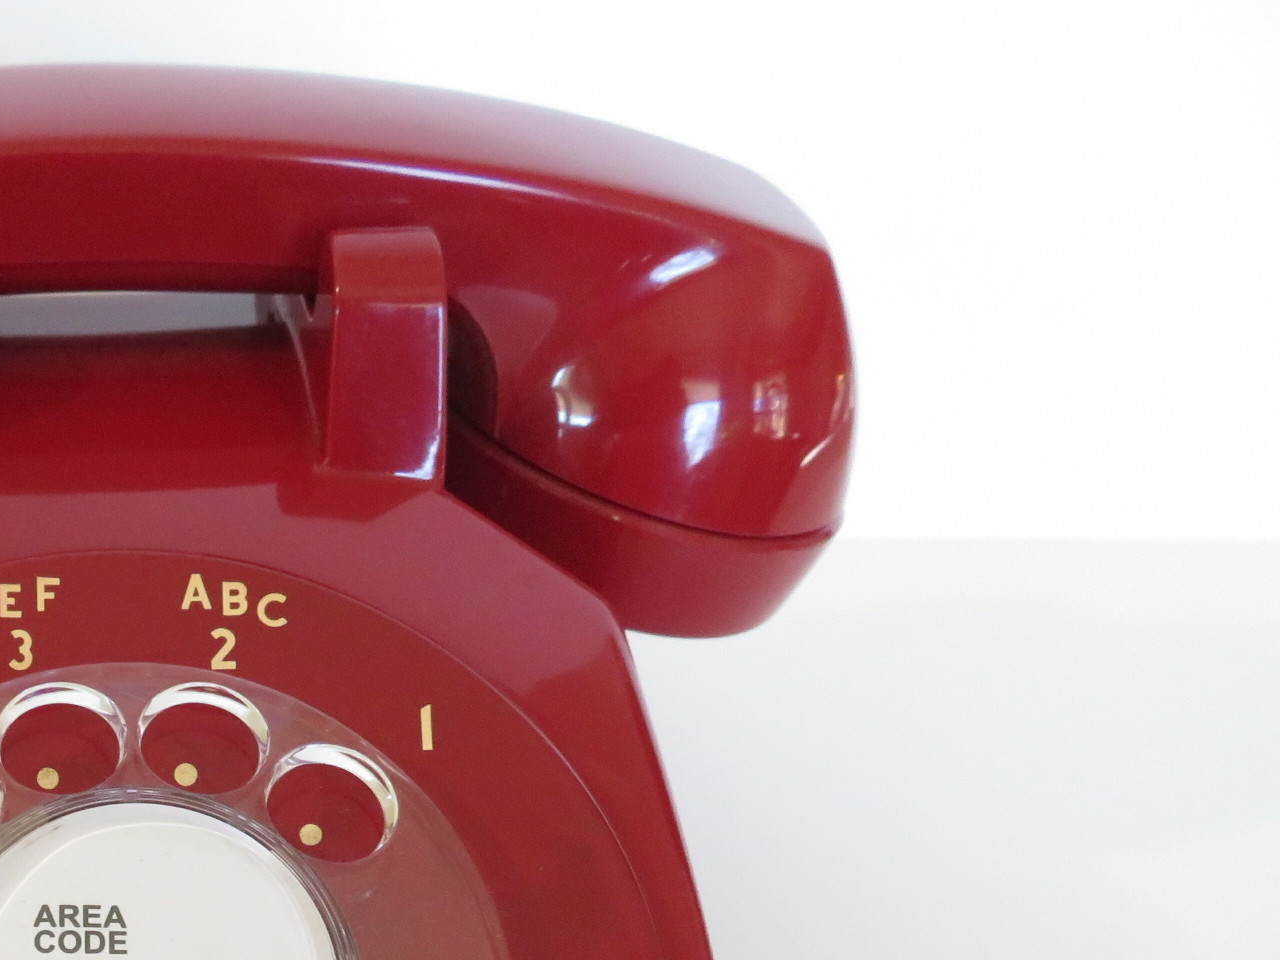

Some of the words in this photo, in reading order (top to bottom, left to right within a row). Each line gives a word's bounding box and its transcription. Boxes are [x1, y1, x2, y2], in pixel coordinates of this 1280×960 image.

[181, 573, 288, 628] ABC
[8, 629, 33, 671] 3
[210, 627, 237, 670] 2
[33, 904, 127, 928] AREA
[33, 929, 129, 955] CODE
